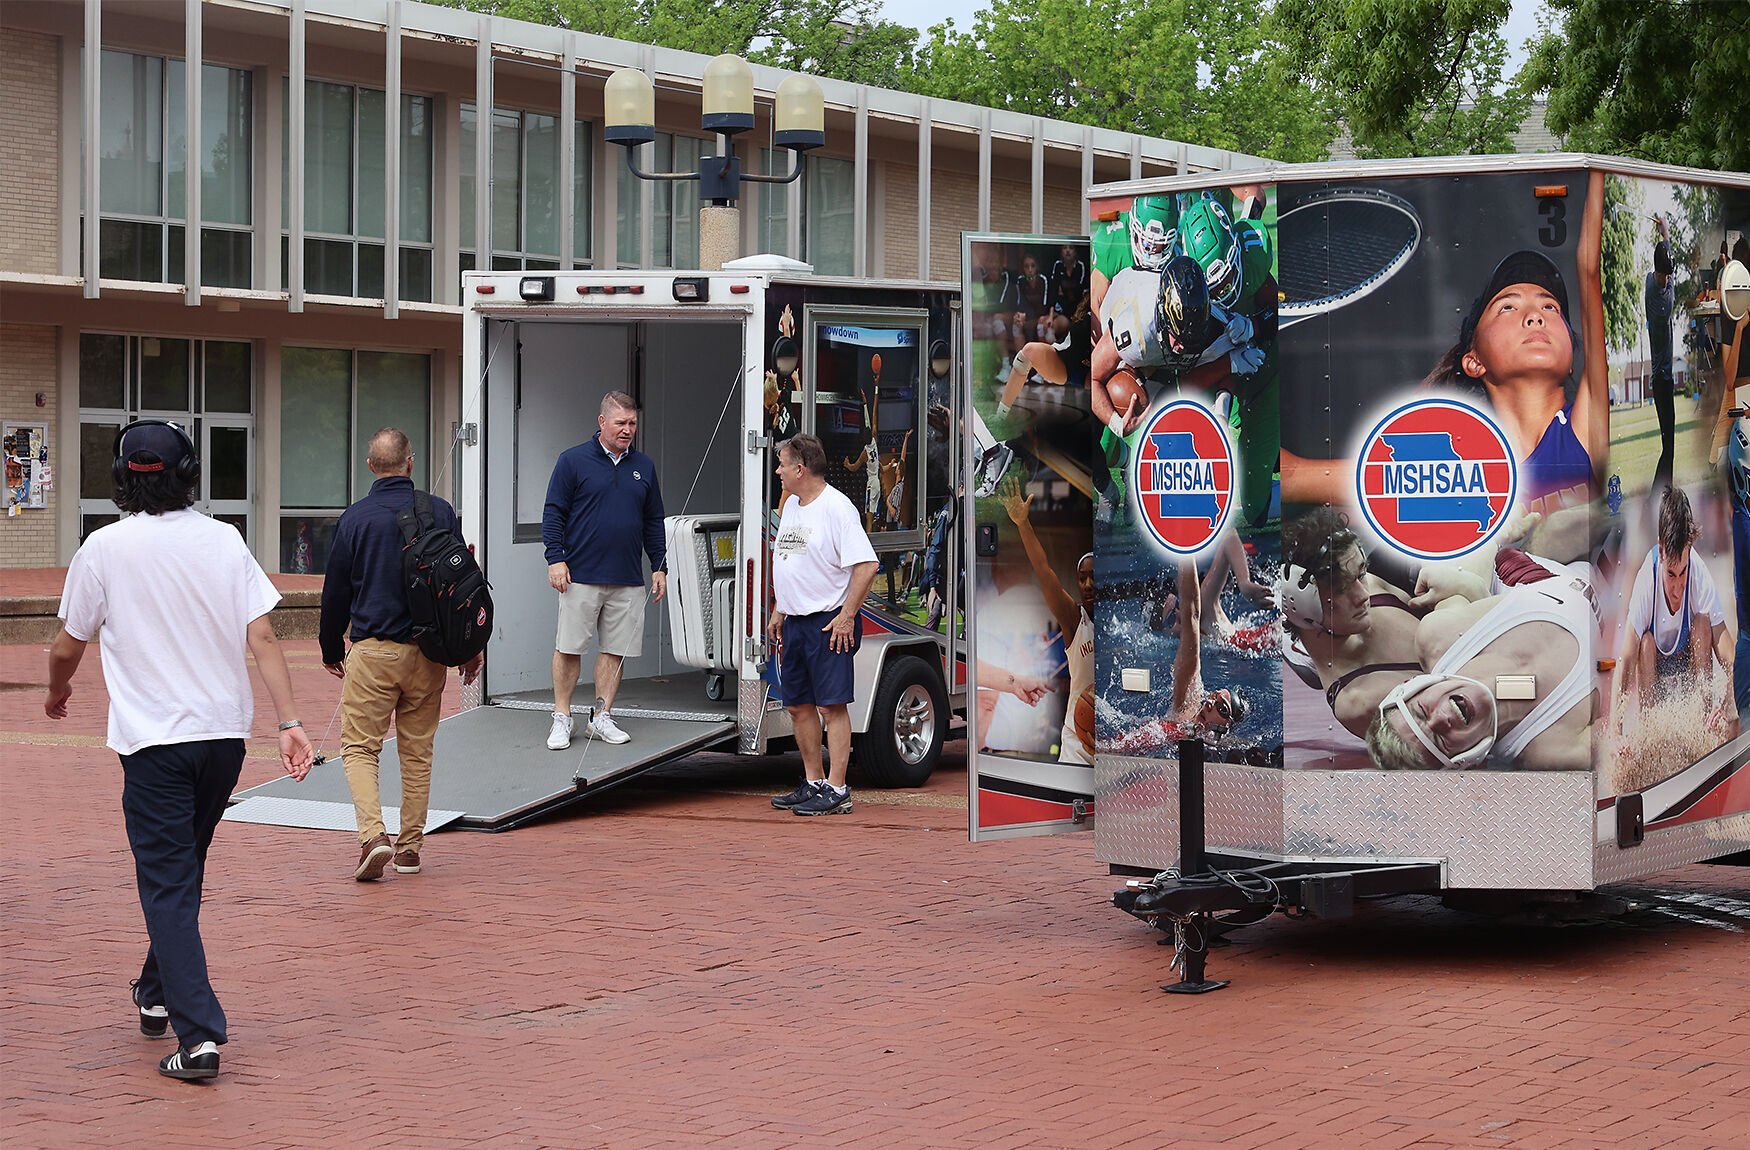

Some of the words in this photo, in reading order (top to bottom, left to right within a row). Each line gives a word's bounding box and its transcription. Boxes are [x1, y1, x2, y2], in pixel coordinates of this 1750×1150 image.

[1538, 200, 1567, 247] 3
[1152, 461, 1214, 491] MSHSAA
[1385, 463, 1485, 494] MSHSAA
